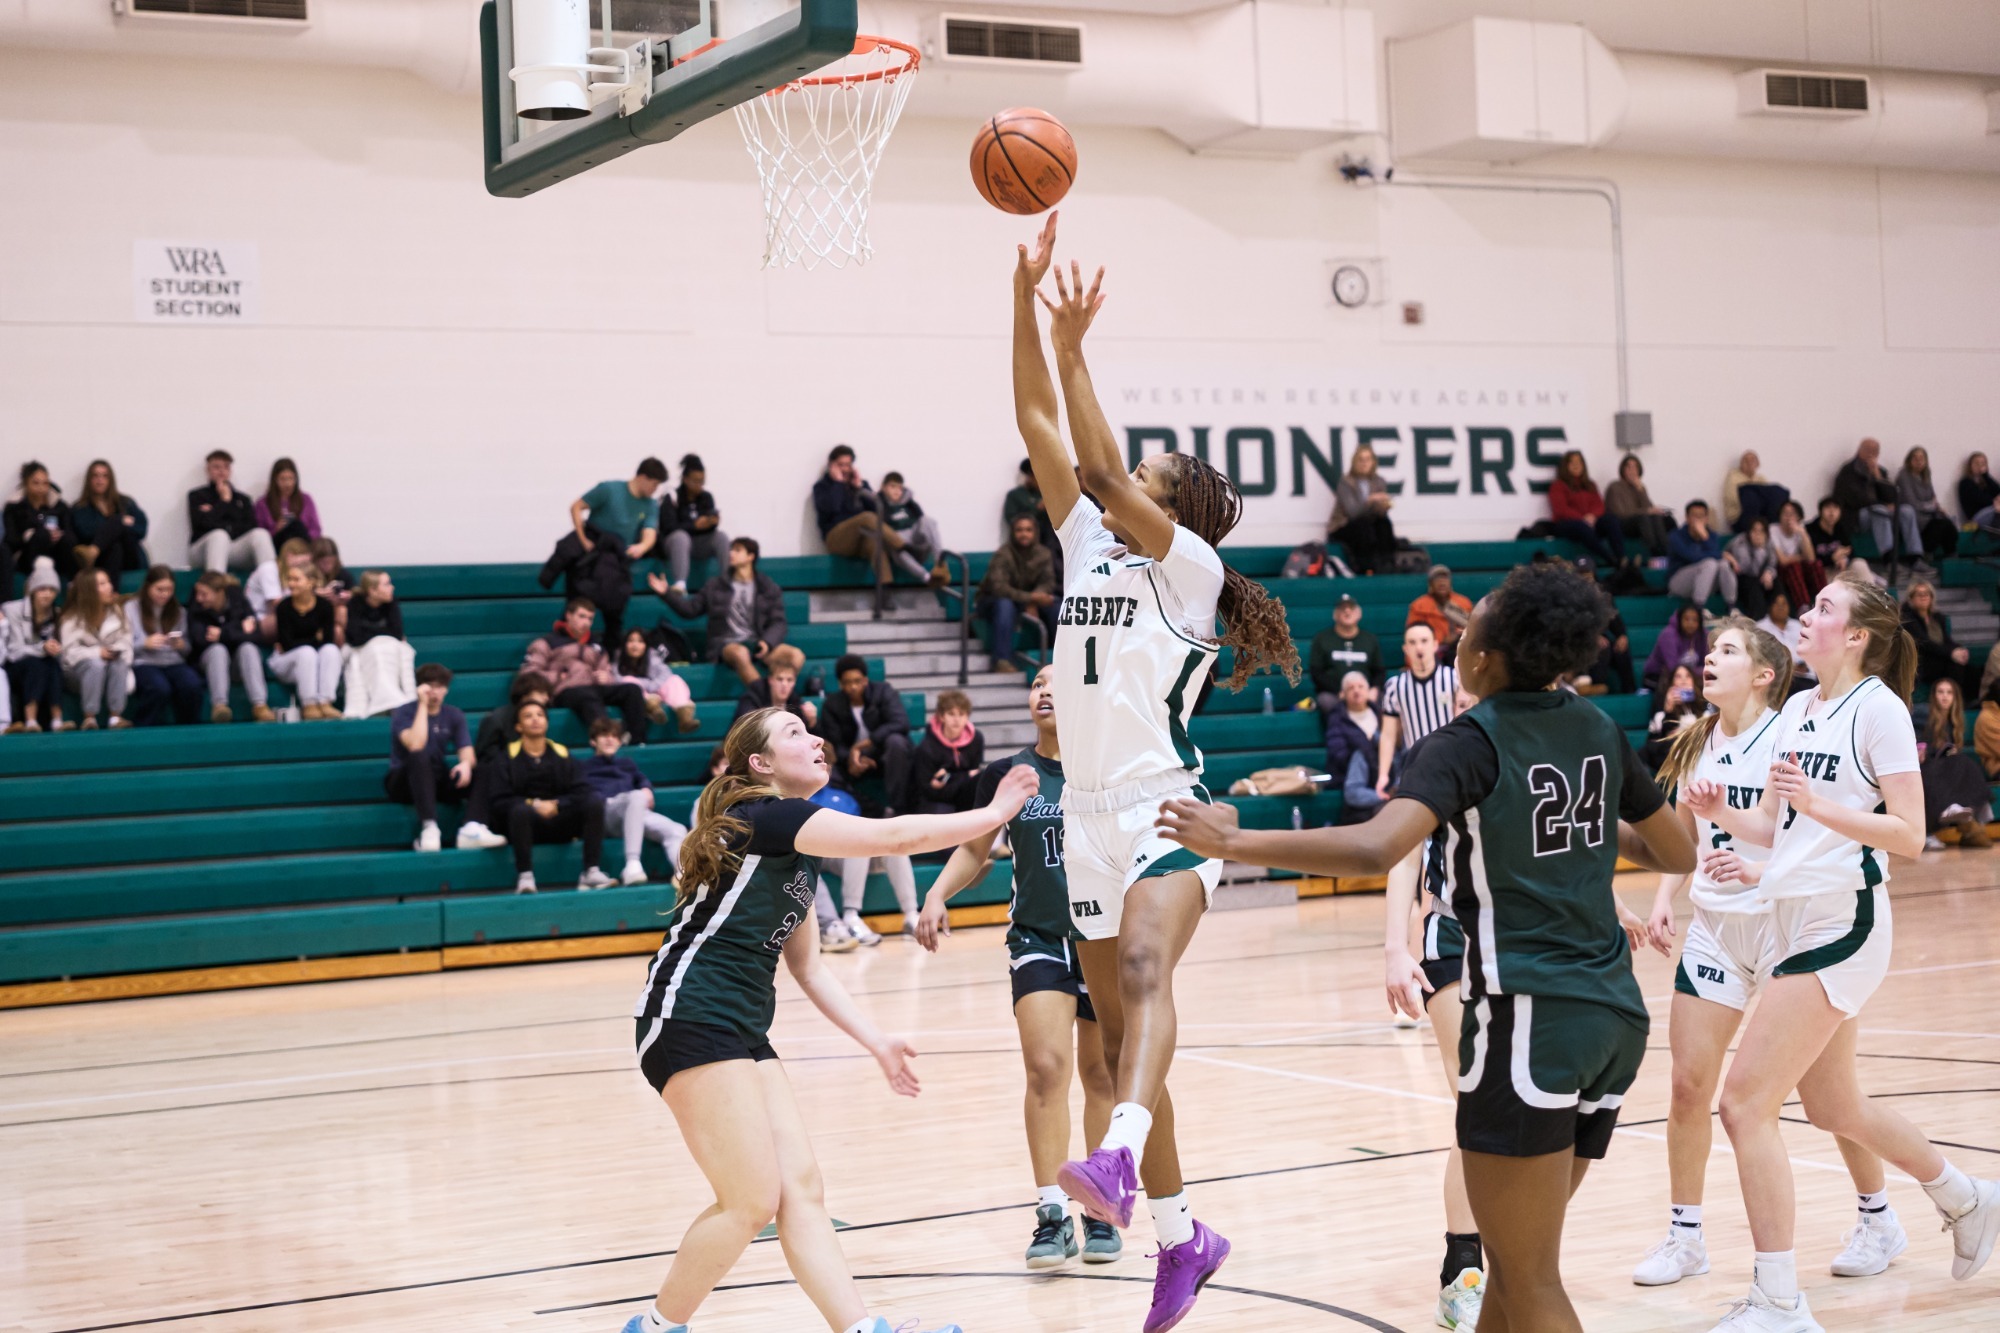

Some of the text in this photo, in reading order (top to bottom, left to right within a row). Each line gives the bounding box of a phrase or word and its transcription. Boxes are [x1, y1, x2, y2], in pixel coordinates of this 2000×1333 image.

[165, 247, 226, 275] WRA
[151, 278, 242, 295] STUDENT
[155, 300, 241, 315] SECTION
[1121, 387, 1569, 407] WESTERN RESERVE ACADEMY
[1057, 596, 1138, 627] ESERVE
[1084, 636, 1099, 685] 1
[1528, 755, 1606, 857] 24
[1071, 900, 1103, 917] WRA
[1697, 964, 1725, 984] WRA
